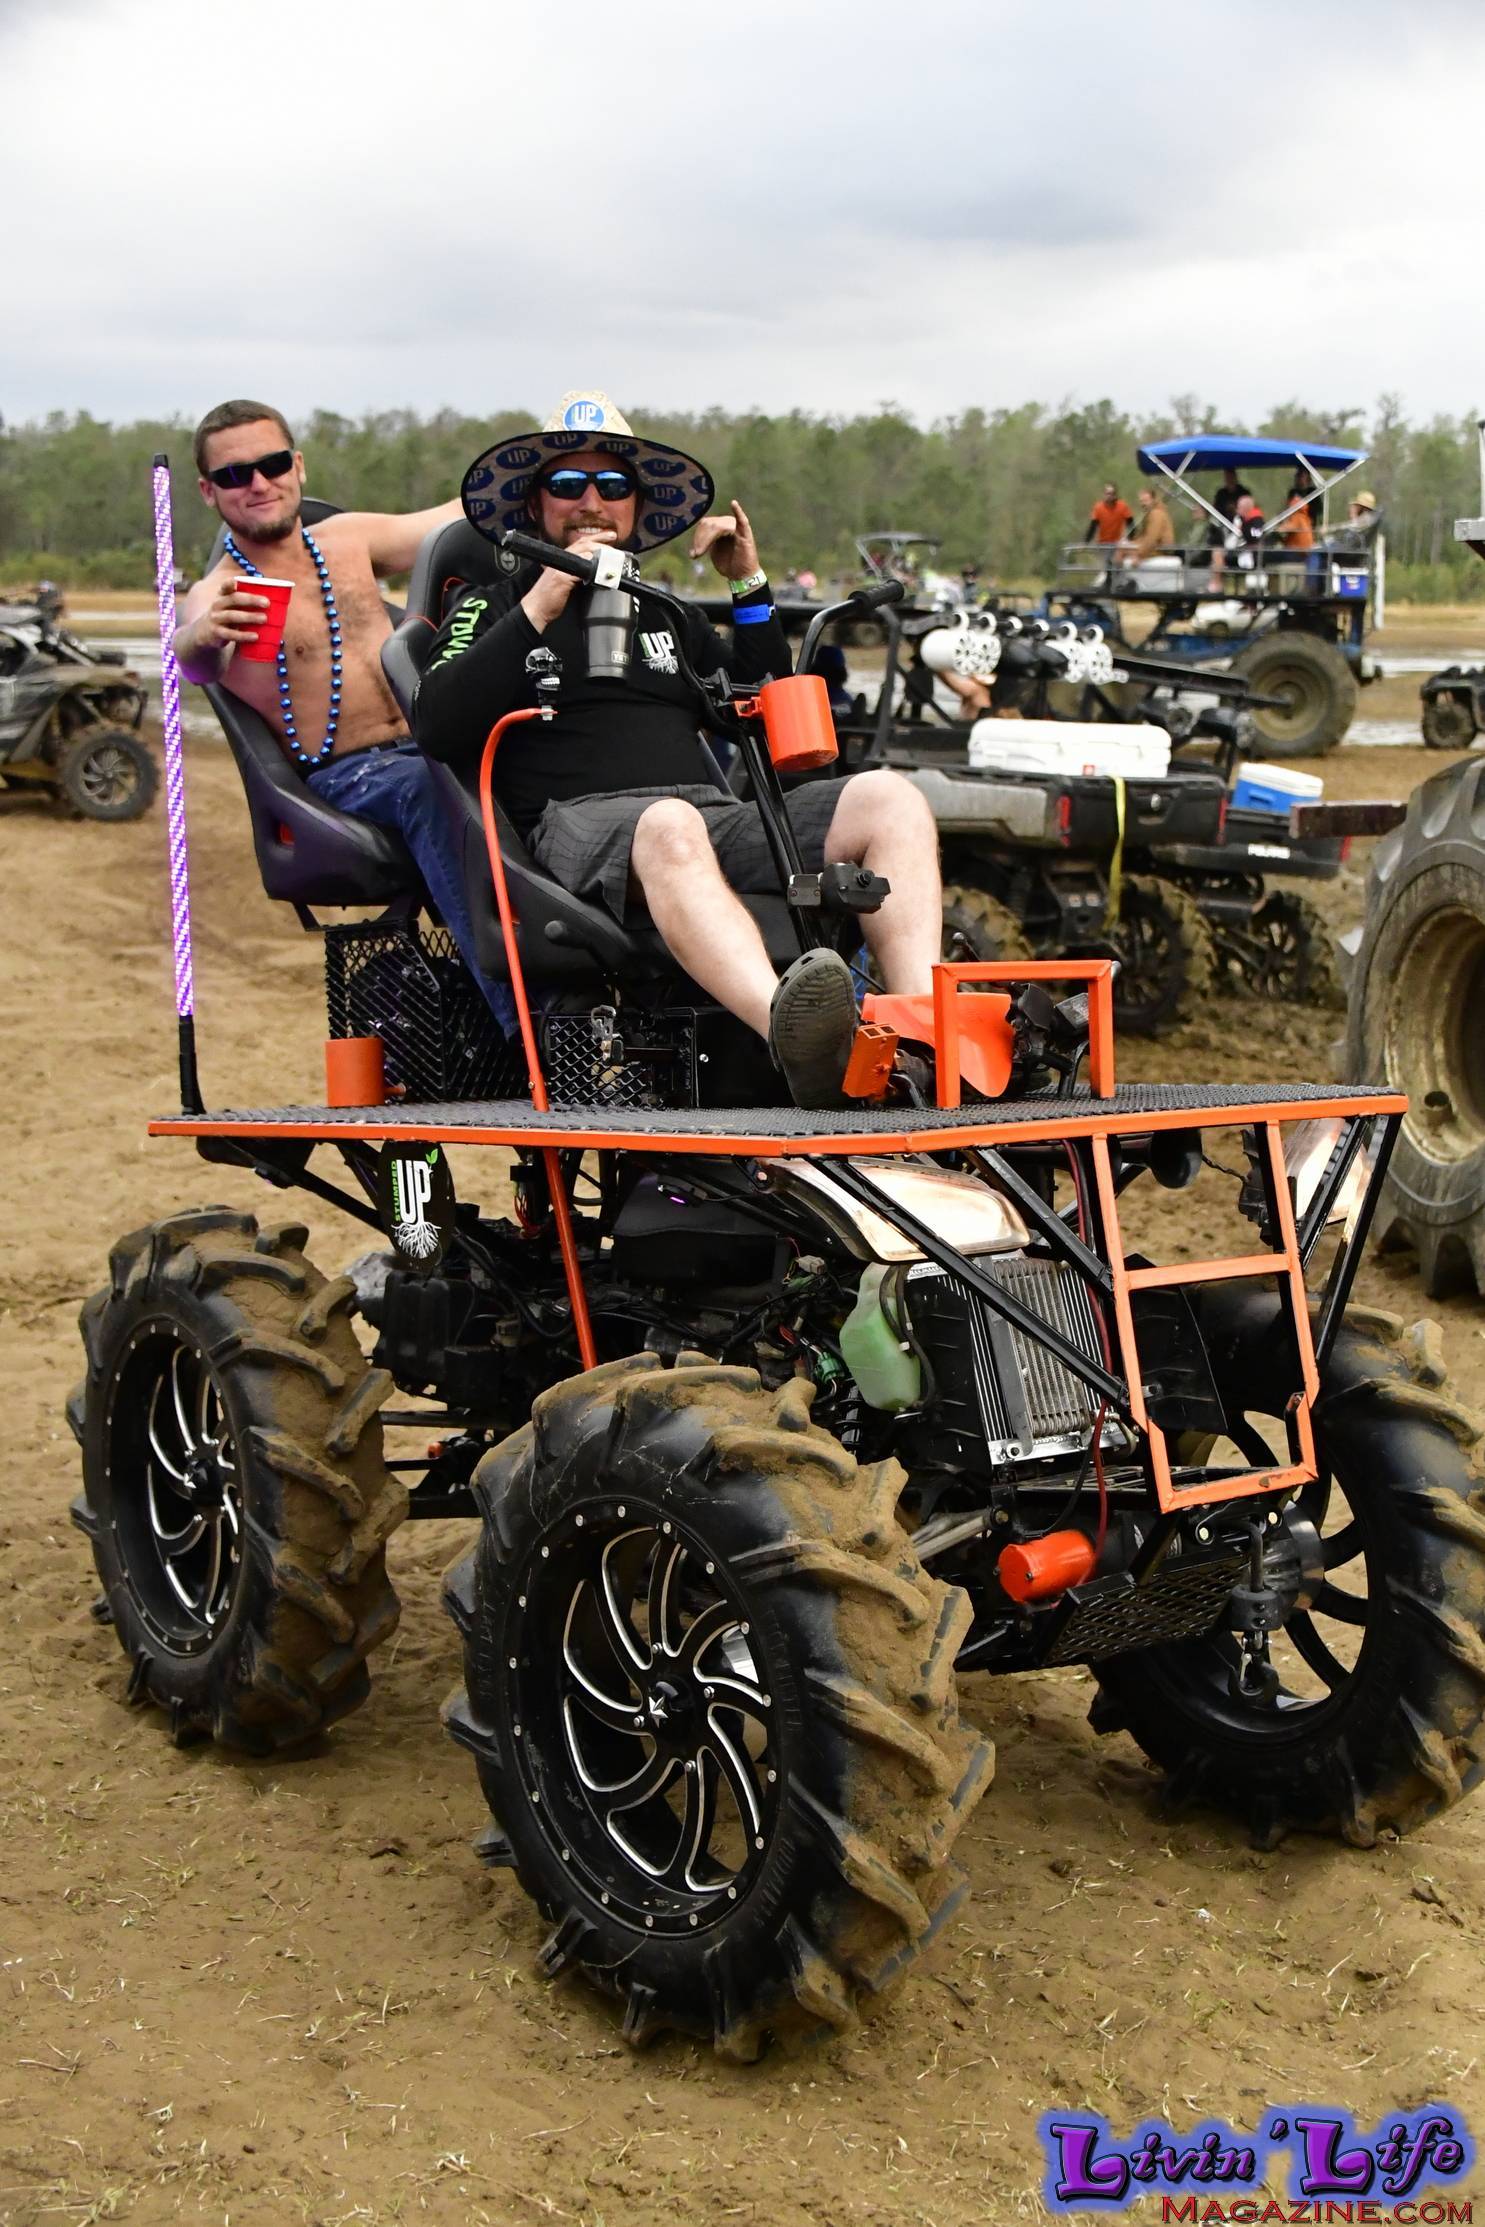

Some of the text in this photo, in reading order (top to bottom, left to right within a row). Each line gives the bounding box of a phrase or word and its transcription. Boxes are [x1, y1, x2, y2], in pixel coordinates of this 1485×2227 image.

[573, 404, 598, 424] UP
[506, 449, 531, 464] UP
[654, 514, 678, 530] UP
[641, 631, 675, 659] UP
[391, 1160, 401, 1222] STUMPED
[396, 1159, 432, 1225] UP
